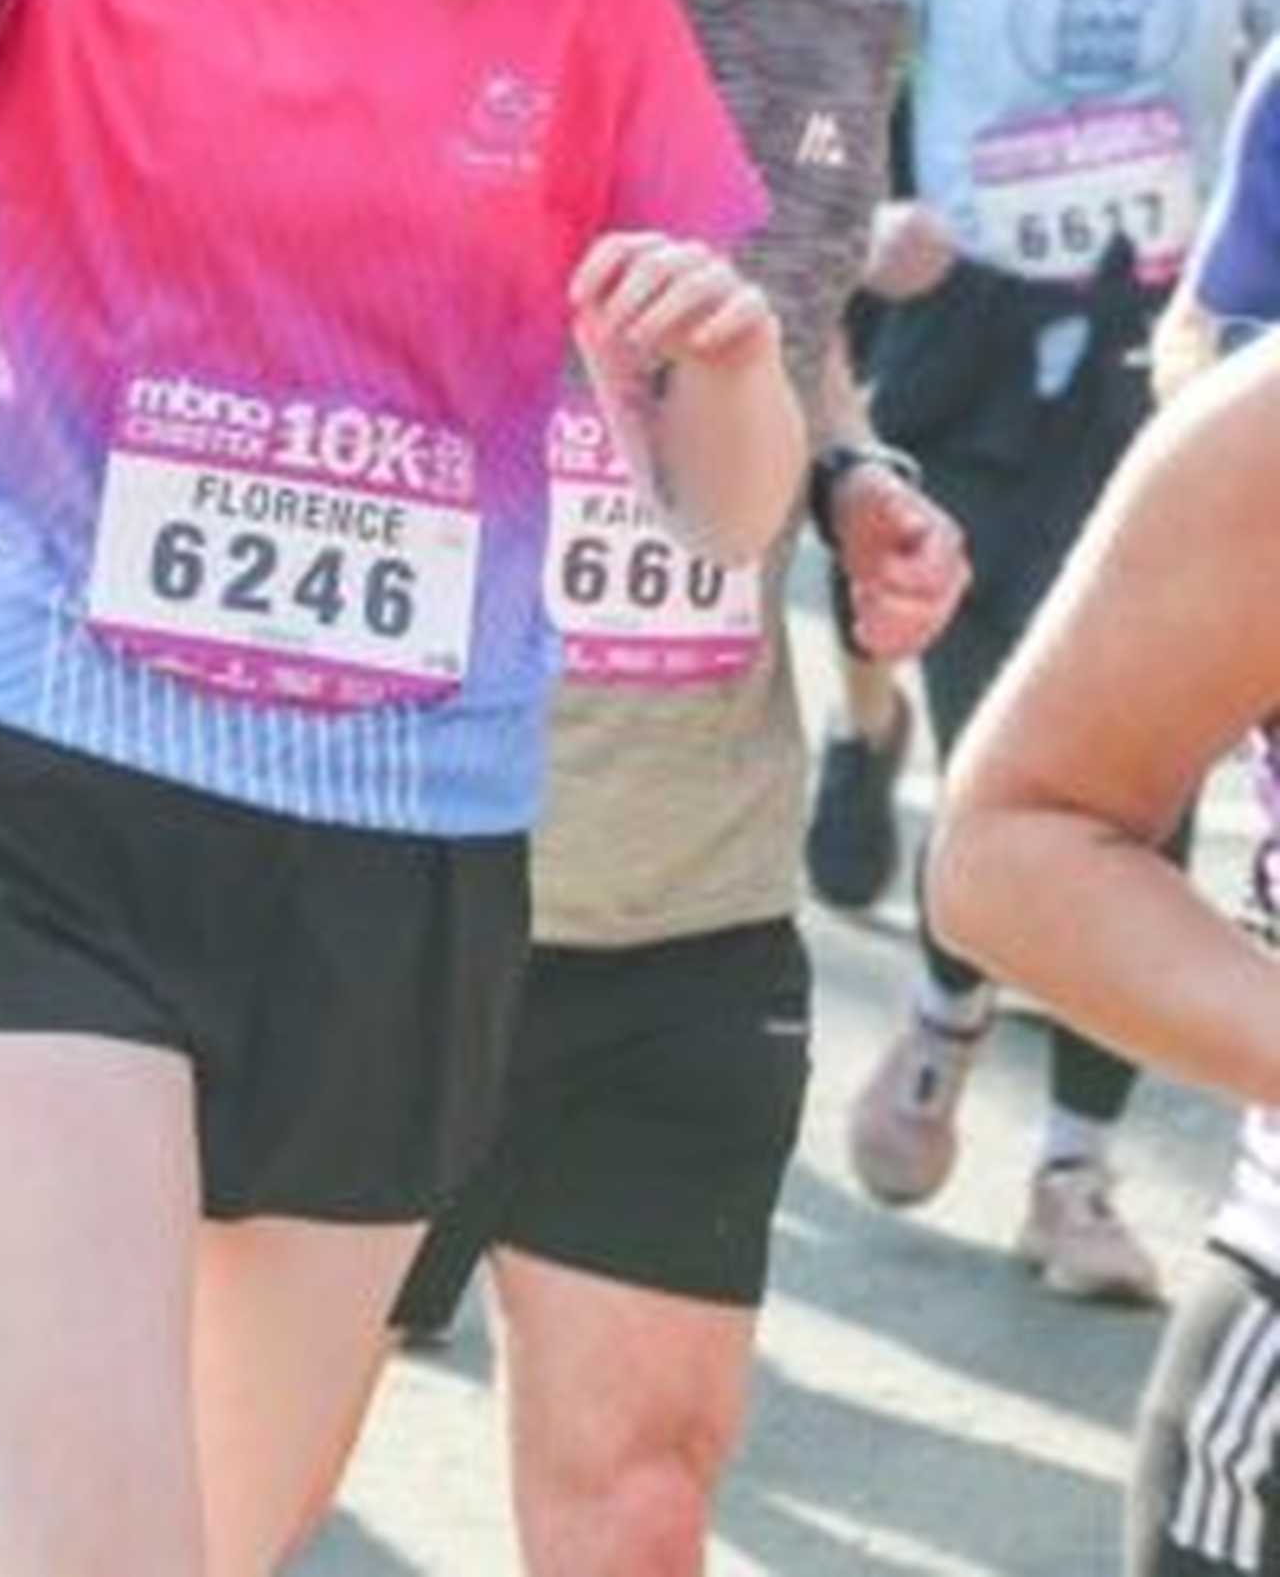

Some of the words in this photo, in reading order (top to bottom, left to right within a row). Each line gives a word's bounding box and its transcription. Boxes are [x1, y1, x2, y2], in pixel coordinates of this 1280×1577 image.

[274, 402, 427, 488] 10K
[185, 474, 408, 546] FLORENCE
[150, 522, 417, 638] 6246
